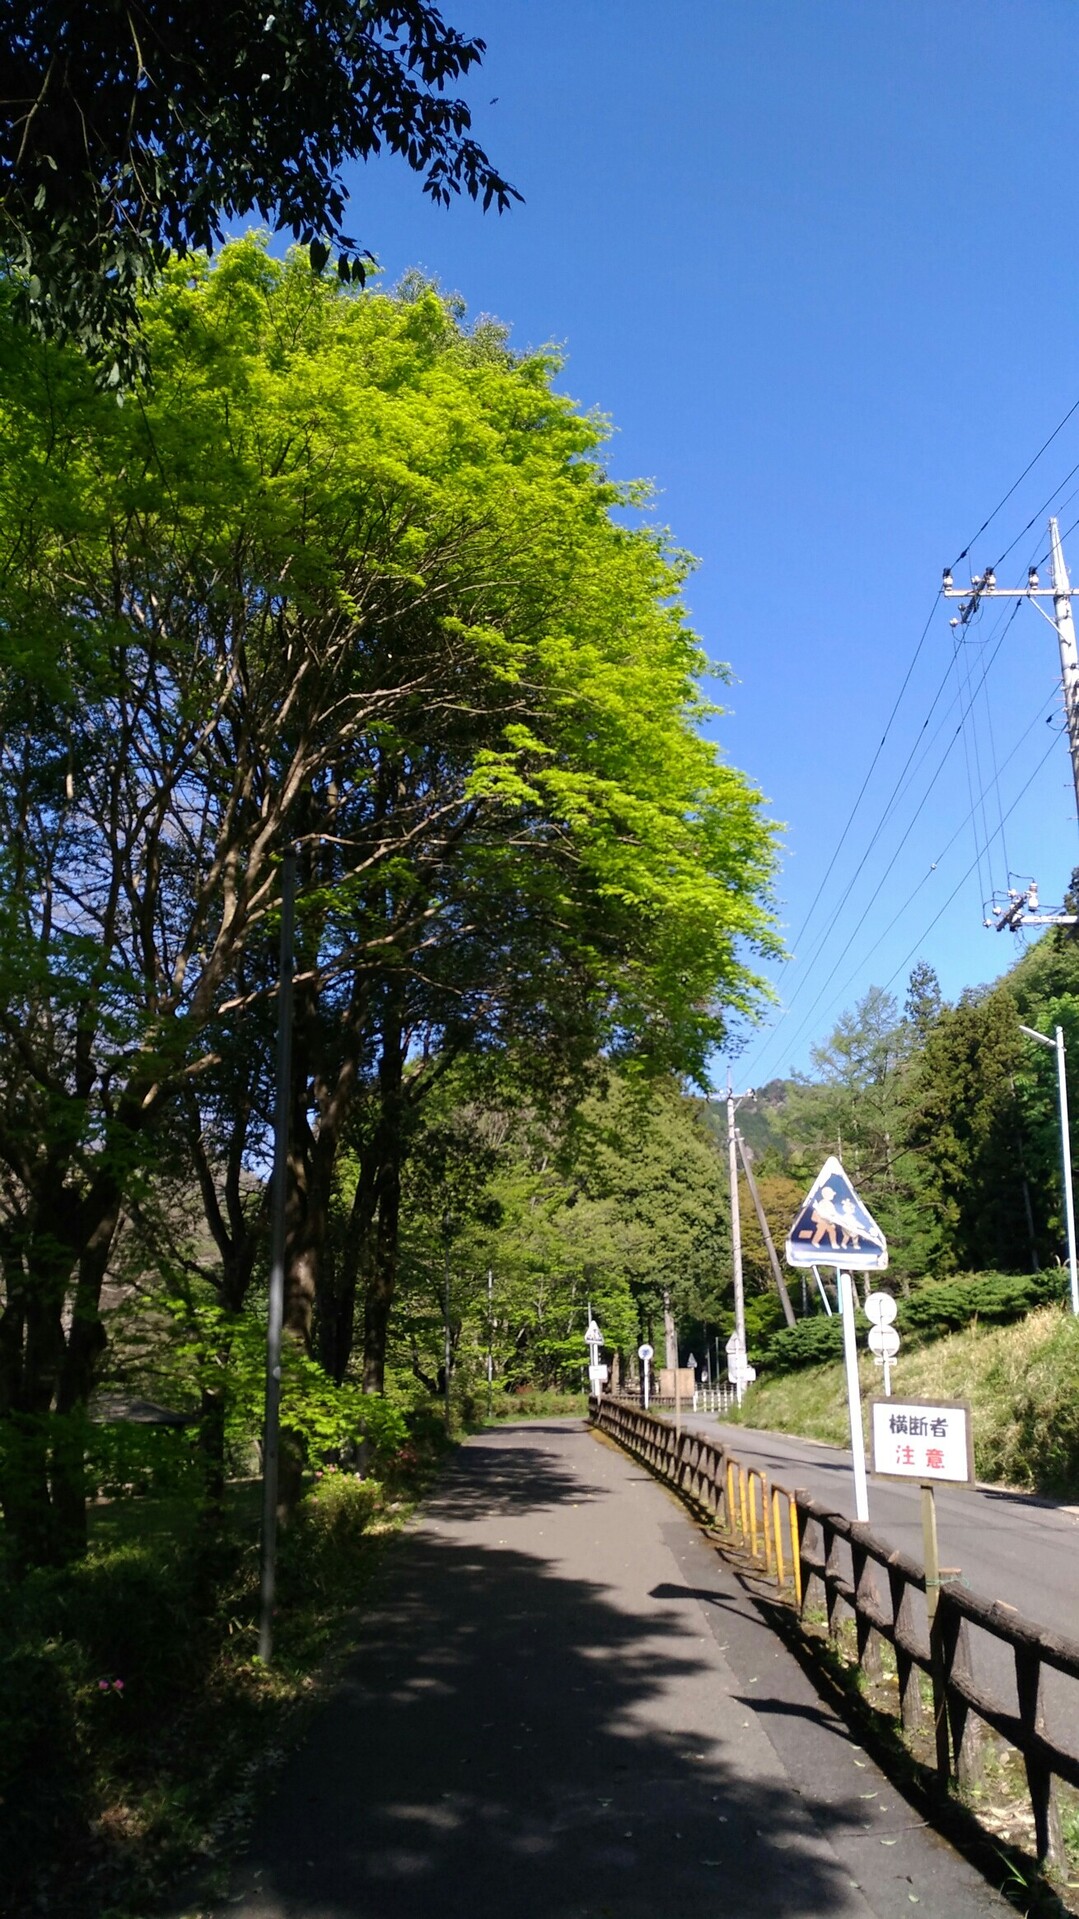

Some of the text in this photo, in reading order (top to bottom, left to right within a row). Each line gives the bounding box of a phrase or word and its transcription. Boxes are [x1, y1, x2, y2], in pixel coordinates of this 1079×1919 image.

[888, 1413, 949, 1438] 横断者
[896, 1445, 945, 1469] 注意
